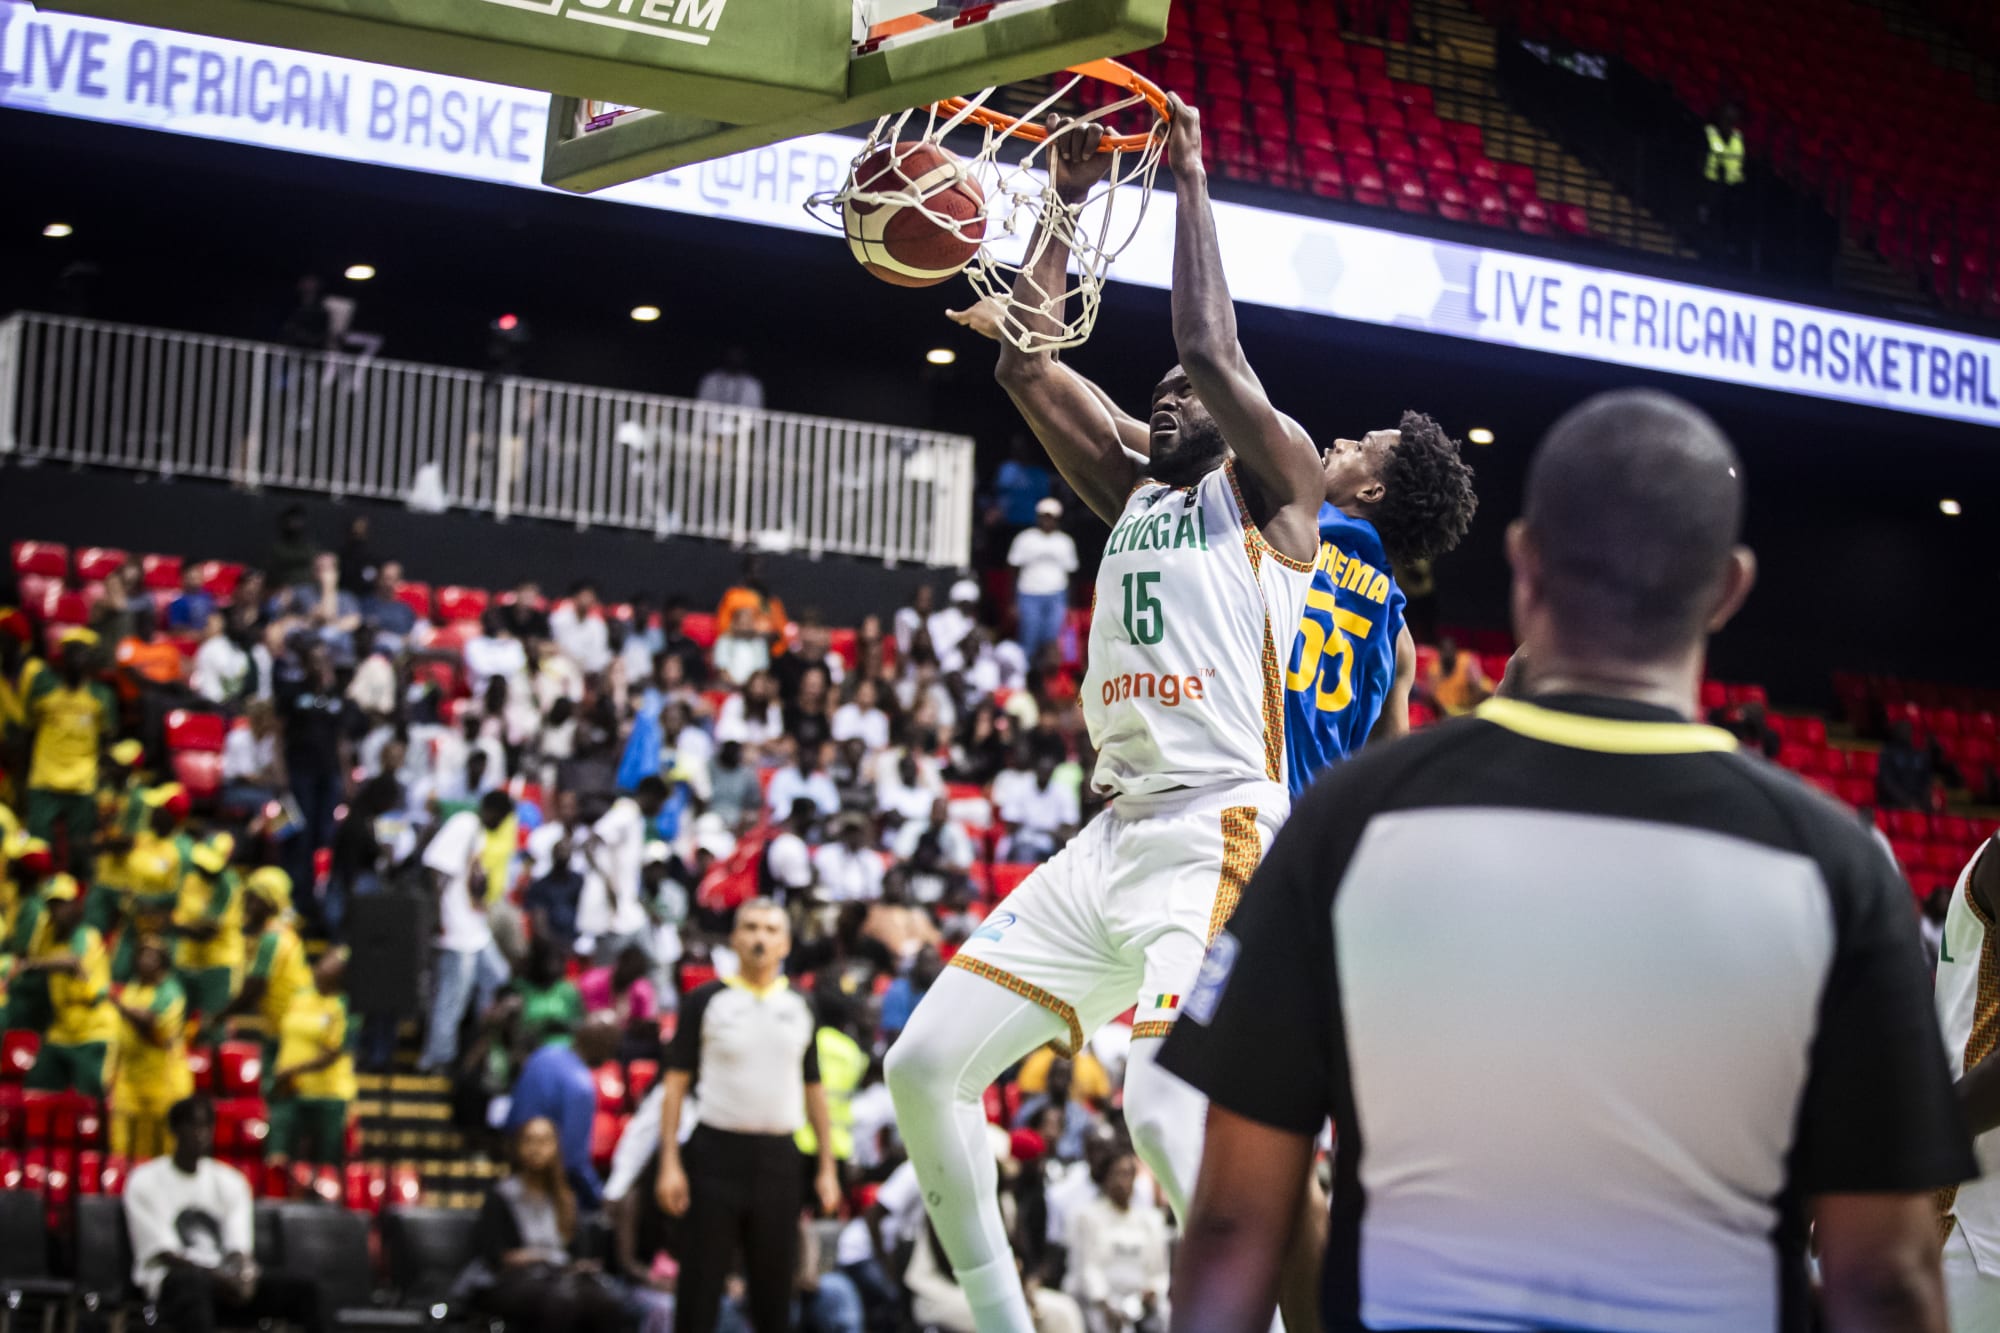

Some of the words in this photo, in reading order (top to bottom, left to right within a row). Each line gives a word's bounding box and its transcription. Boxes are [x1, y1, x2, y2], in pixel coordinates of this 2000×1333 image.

[0, 22, 110, 98] LIVE
[126, 39, 350, 135] AFRICAN
[368, 79, 546, 162] BASKE
[1470, 265, 1562, 332] LIVE
[1579, 284, 1756, 367] AFRICAN
[1771, 319, 2000, 409] BASKETBAL
[1103, 505, 1209, 557] ENEGAL
[1121, 571, 1164, 645] 15
[1102, 673, 1203, 706] orange
